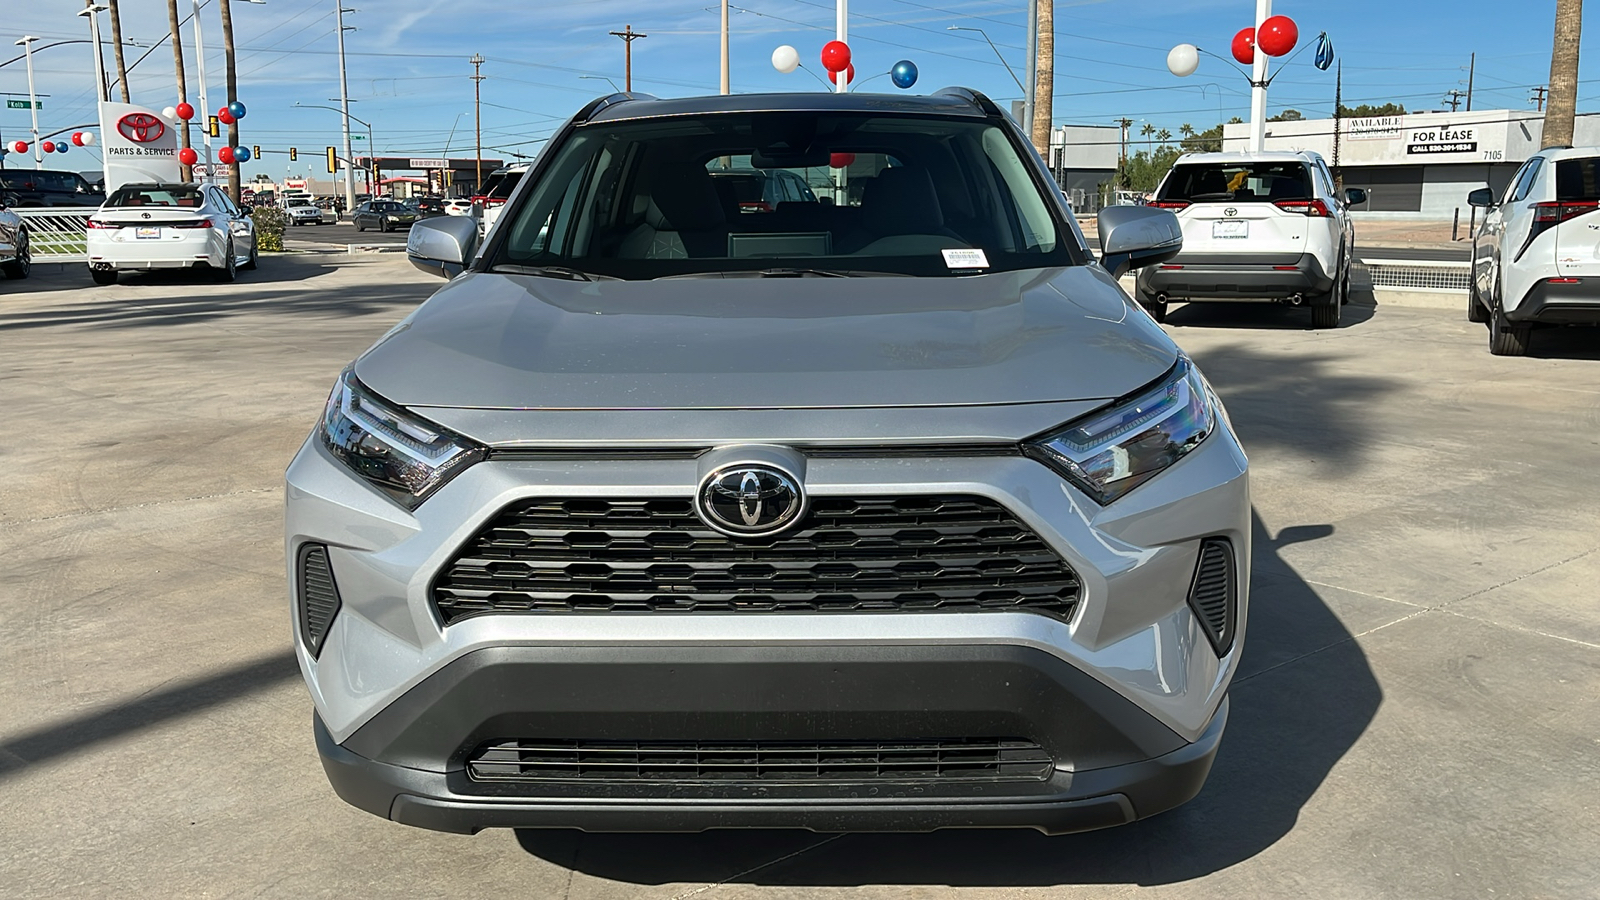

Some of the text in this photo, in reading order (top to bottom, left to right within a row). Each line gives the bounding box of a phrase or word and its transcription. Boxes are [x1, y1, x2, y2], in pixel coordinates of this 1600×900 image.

[1350, 117, 1401, 127] AVAILABLE
[1413, 130, 1473, 142] FOR LEASE
[109, 147, 175, 156] PARTS & SERVICE
[1412, 145, 1428, 153] CALL
[1483, 150, 1503, 160] 7105
